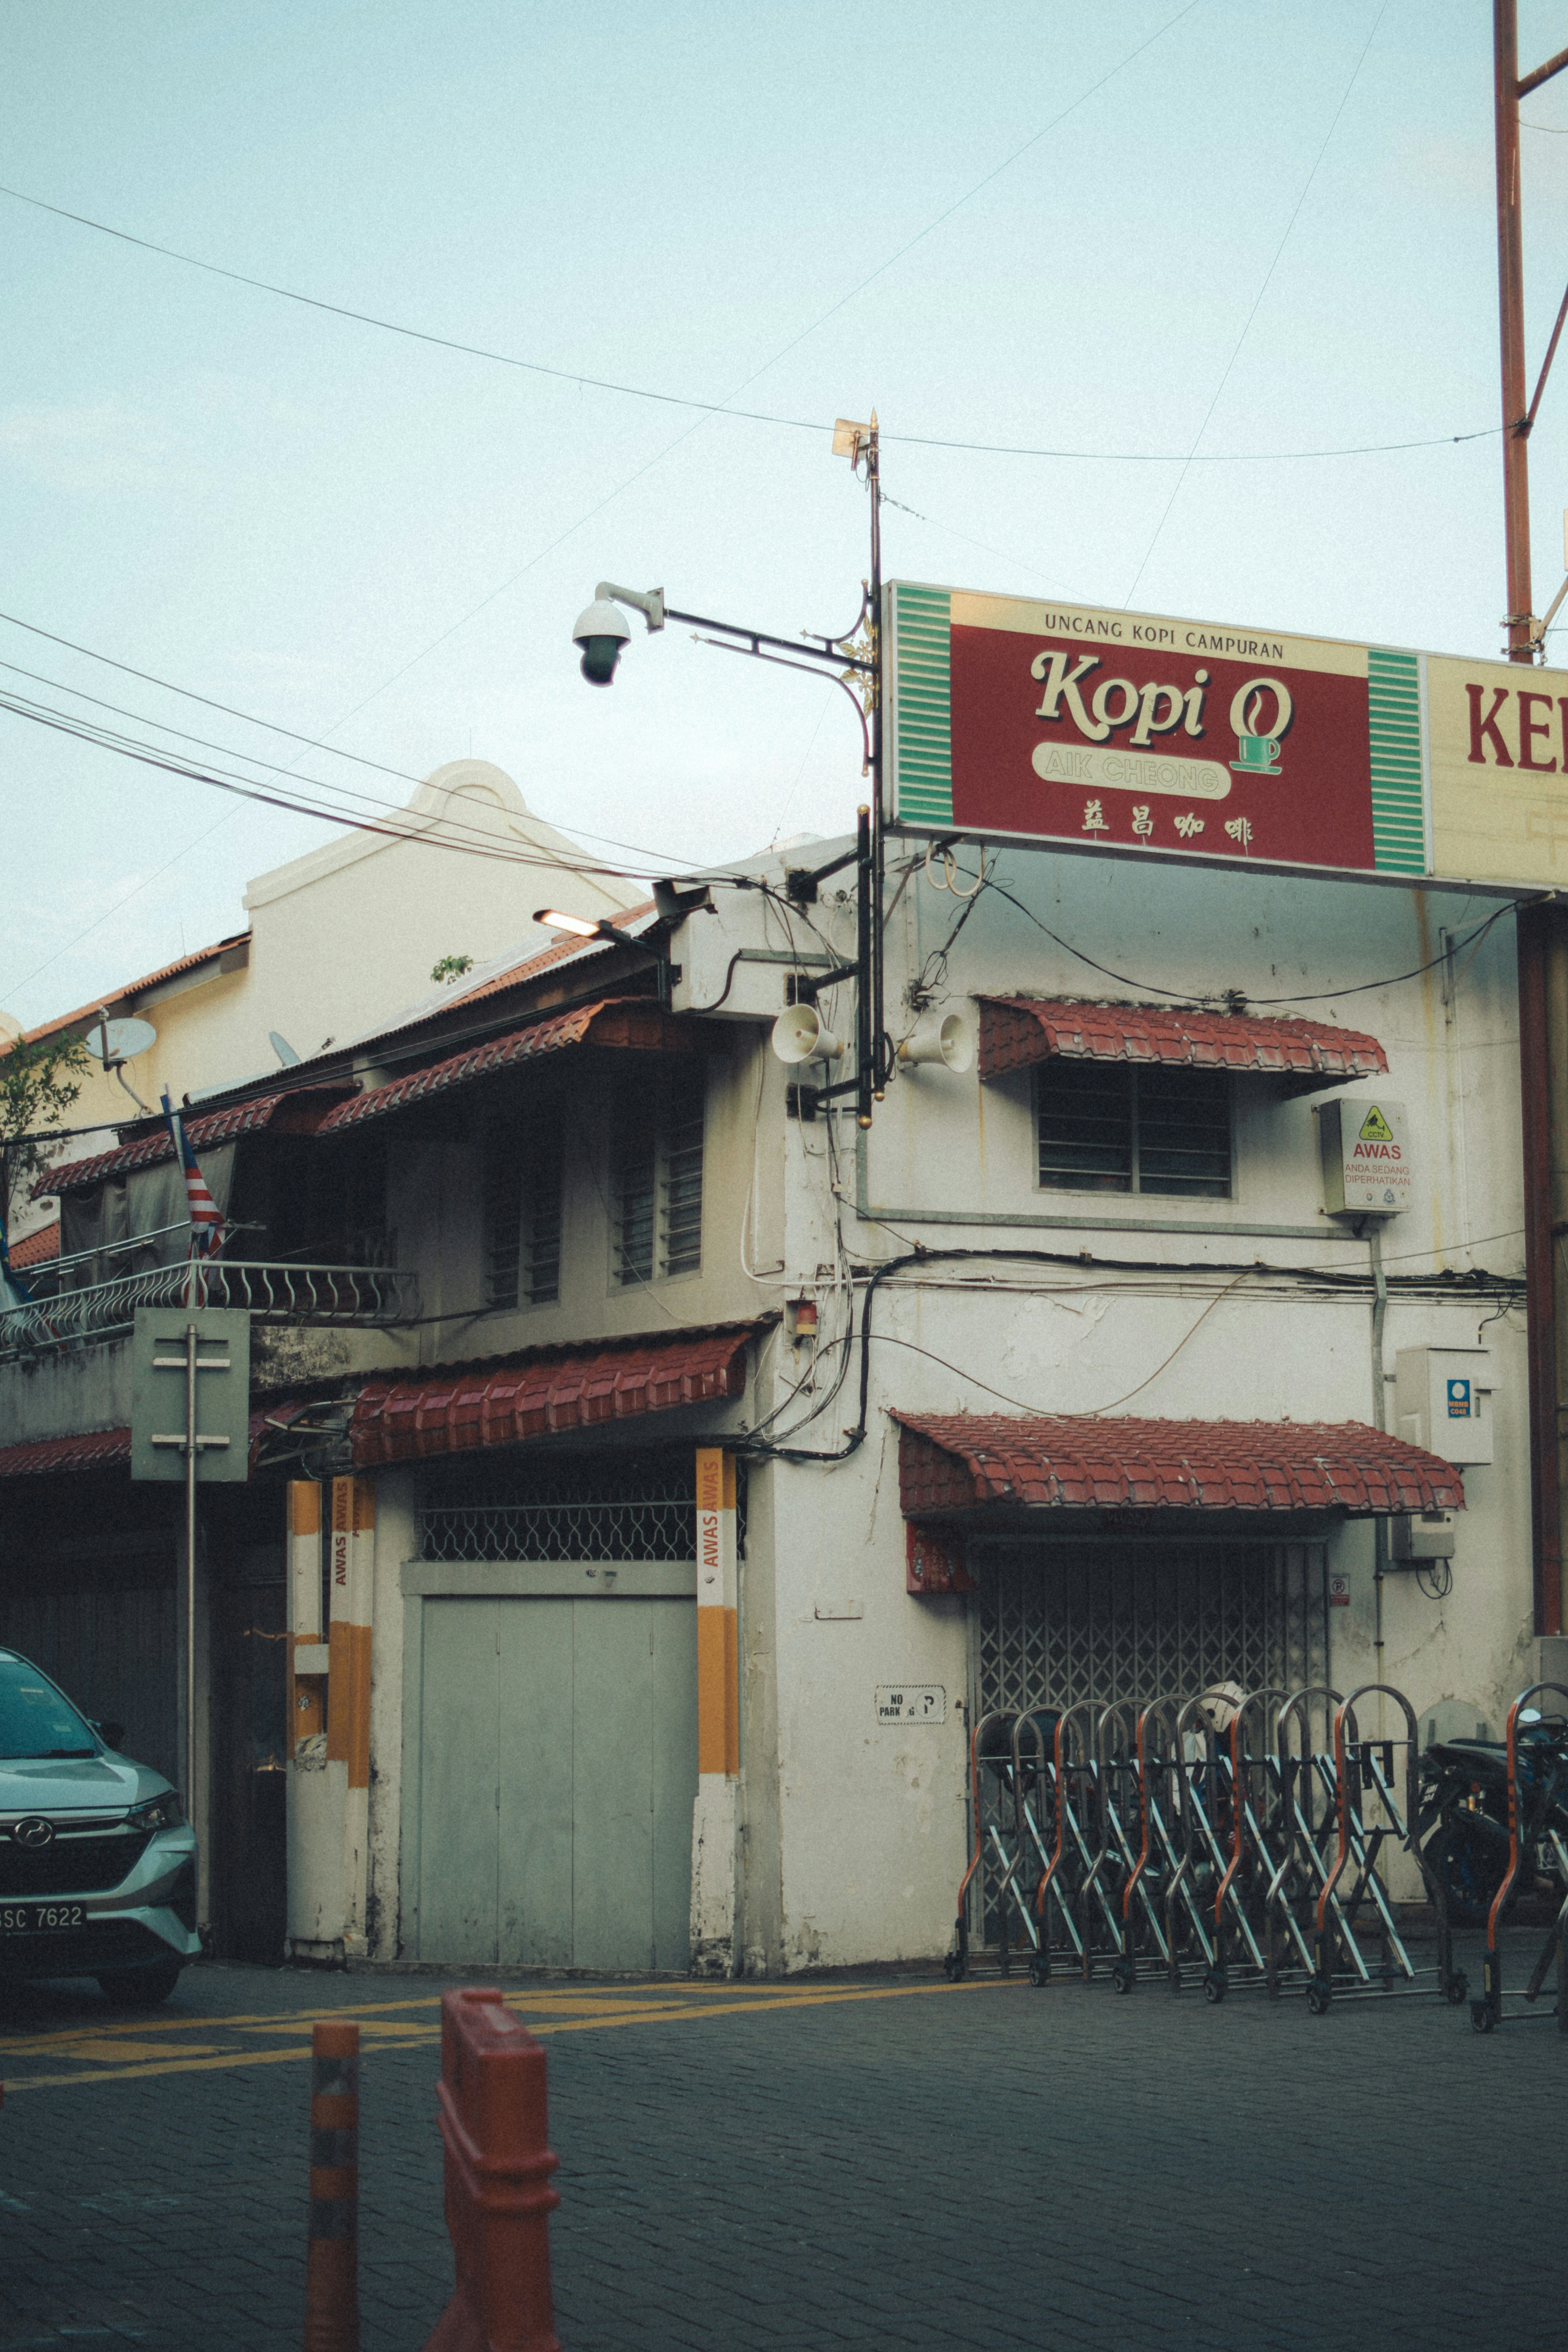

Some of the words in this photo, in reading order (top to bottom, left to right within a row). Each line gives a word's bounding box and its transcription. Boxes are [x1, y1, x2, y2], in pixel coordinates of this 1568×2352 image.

[1045, 614, 1122, 637] UNCANG
[1133, 625, 1174, 644] KOPI
[1186, 632, 1283, 659] CAMPURAN
[1031, 651, 1208, 744] Kopi
[1046, 751, 1092, 778] AIK
[1103, 757, 1218, 791] CHEONG
[1082, 800, 1253, 845] 益昌咖啡
[1345, 1164, 1370, 1173] ANDA
[1372, 1166, 1409, 1175] SEDANG
[1354, 1143, 1401, 1160] AWAS
[1345, 1175, 1410, 1186] DIPERHATIKAN
[337, 1481, 347, 1532] AWAS
[702, 1461, 719, 1512] AWAS
[336, 1536, 346, 1586] AWAS
[703, 1516, 718, 1567] AWAS
[880, 1706, 915, 1716] PARKG
[891, 1694, 903, 1704] NO
[0, 1909, 26, 1928] SC
[37, 1907, 82, 1927] 7622
